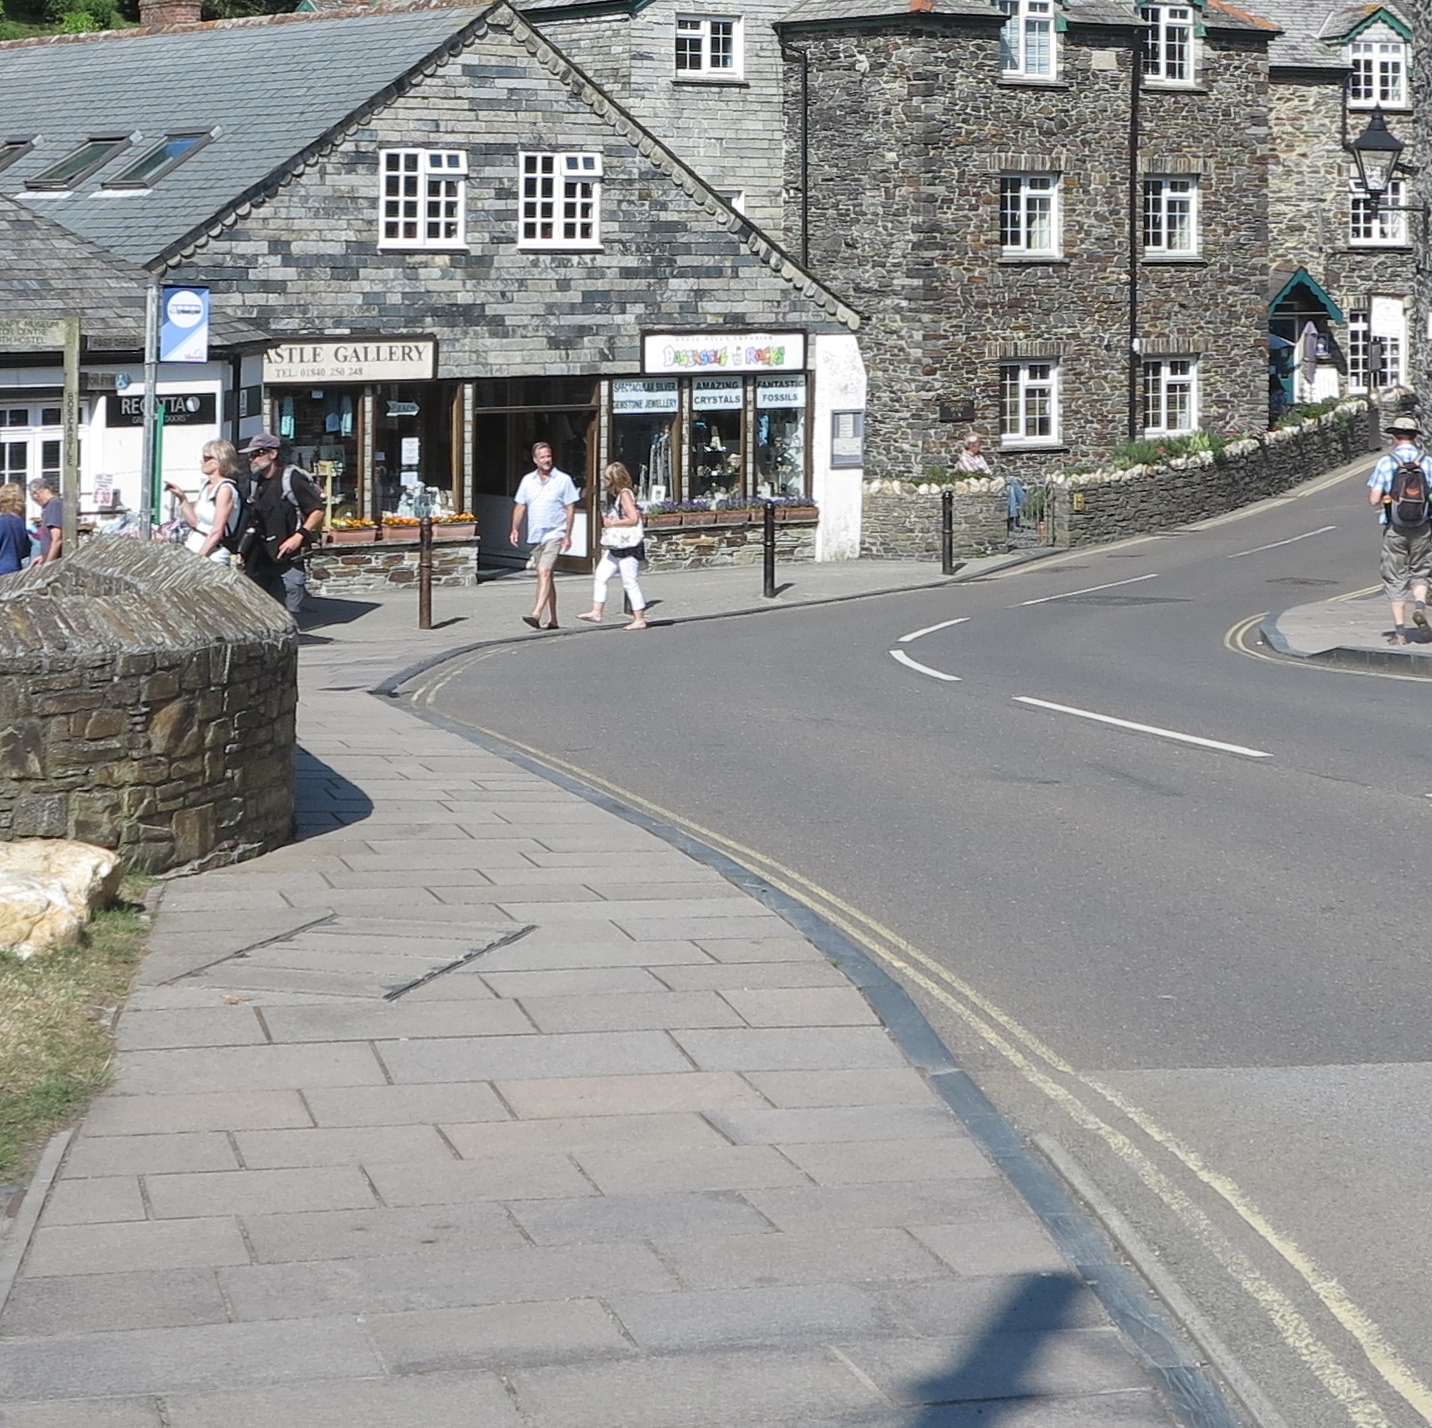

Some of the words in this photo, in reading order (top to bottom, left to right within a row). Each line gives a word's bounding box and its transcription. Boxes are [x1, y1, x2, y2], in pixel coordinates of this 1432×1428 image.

[334, 345, 428, 364] GALLERY
[745, 346, 786, 367] ROCKS
[300, 367, 326, 378] 01840
[613, 381, 654, 392] SPECTACULAR
[655, 381, 676, 392] SILVER
[695, 381, 739, 390] AMAZING
[757, 379, 804, 389] FANTASTIC
[645, 398, 677, 409] JEWELLERY
[694, 395, 741, 405] CRYSTALS
[762, 393, 798, 403] FOSSILS
[66, 392, 75, 466] BOSCASTLE
